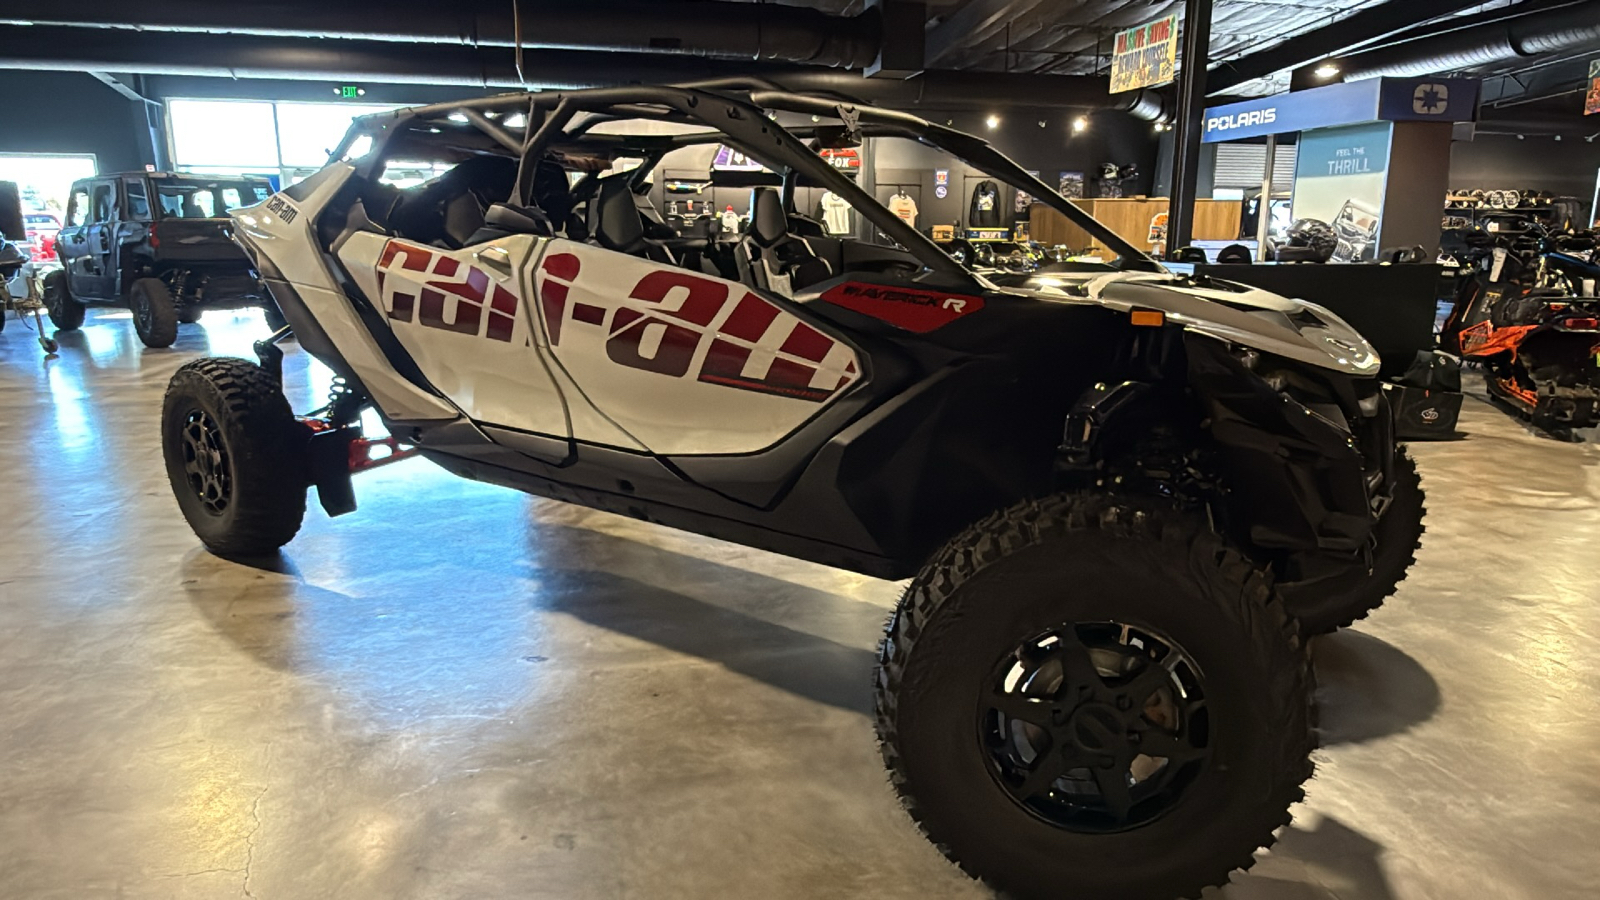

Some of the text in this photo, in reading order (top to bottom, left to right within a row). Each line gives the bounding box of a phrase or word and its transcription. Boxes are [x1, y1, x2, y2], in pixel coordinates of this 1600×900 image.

[342, 86, 357, 98] EXIT
[1207, 107, 1277, 133] POLARIS
[1336, 147, 1365, 157] FEEL THE
[828, 157, 850, 168] FOX
[1327, 157, 1371, 175] THRILL
[266, 195, 298, 225] can-am
[942, 298, 967, 313] R
